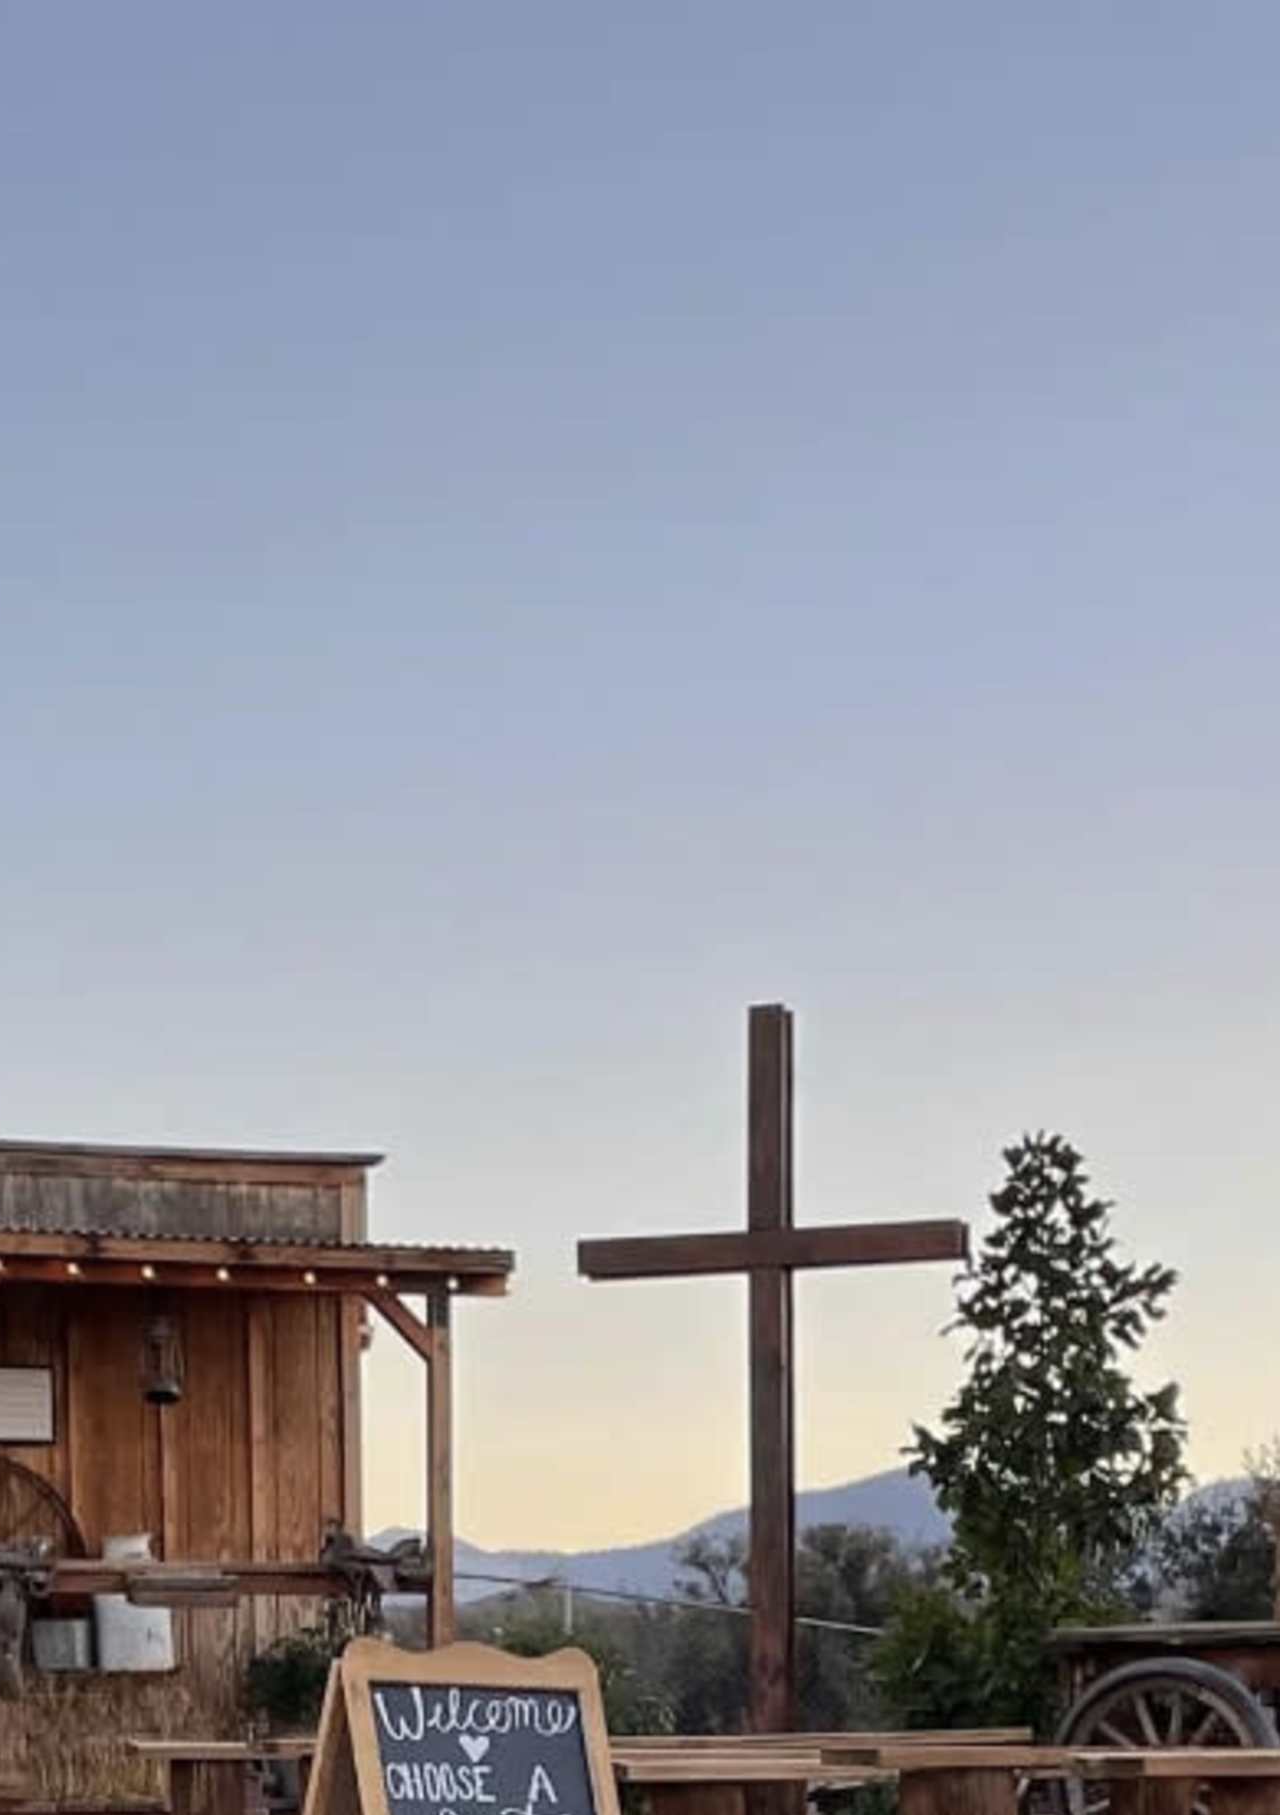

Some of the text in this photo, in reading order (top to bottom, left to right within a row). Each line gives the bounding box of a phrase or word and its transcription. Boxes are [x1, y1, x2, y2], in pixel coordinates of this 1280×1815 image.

[374, 1687, 576, 1741] Welcome
[386, 1762, 558, 1803] CHOOSE A
